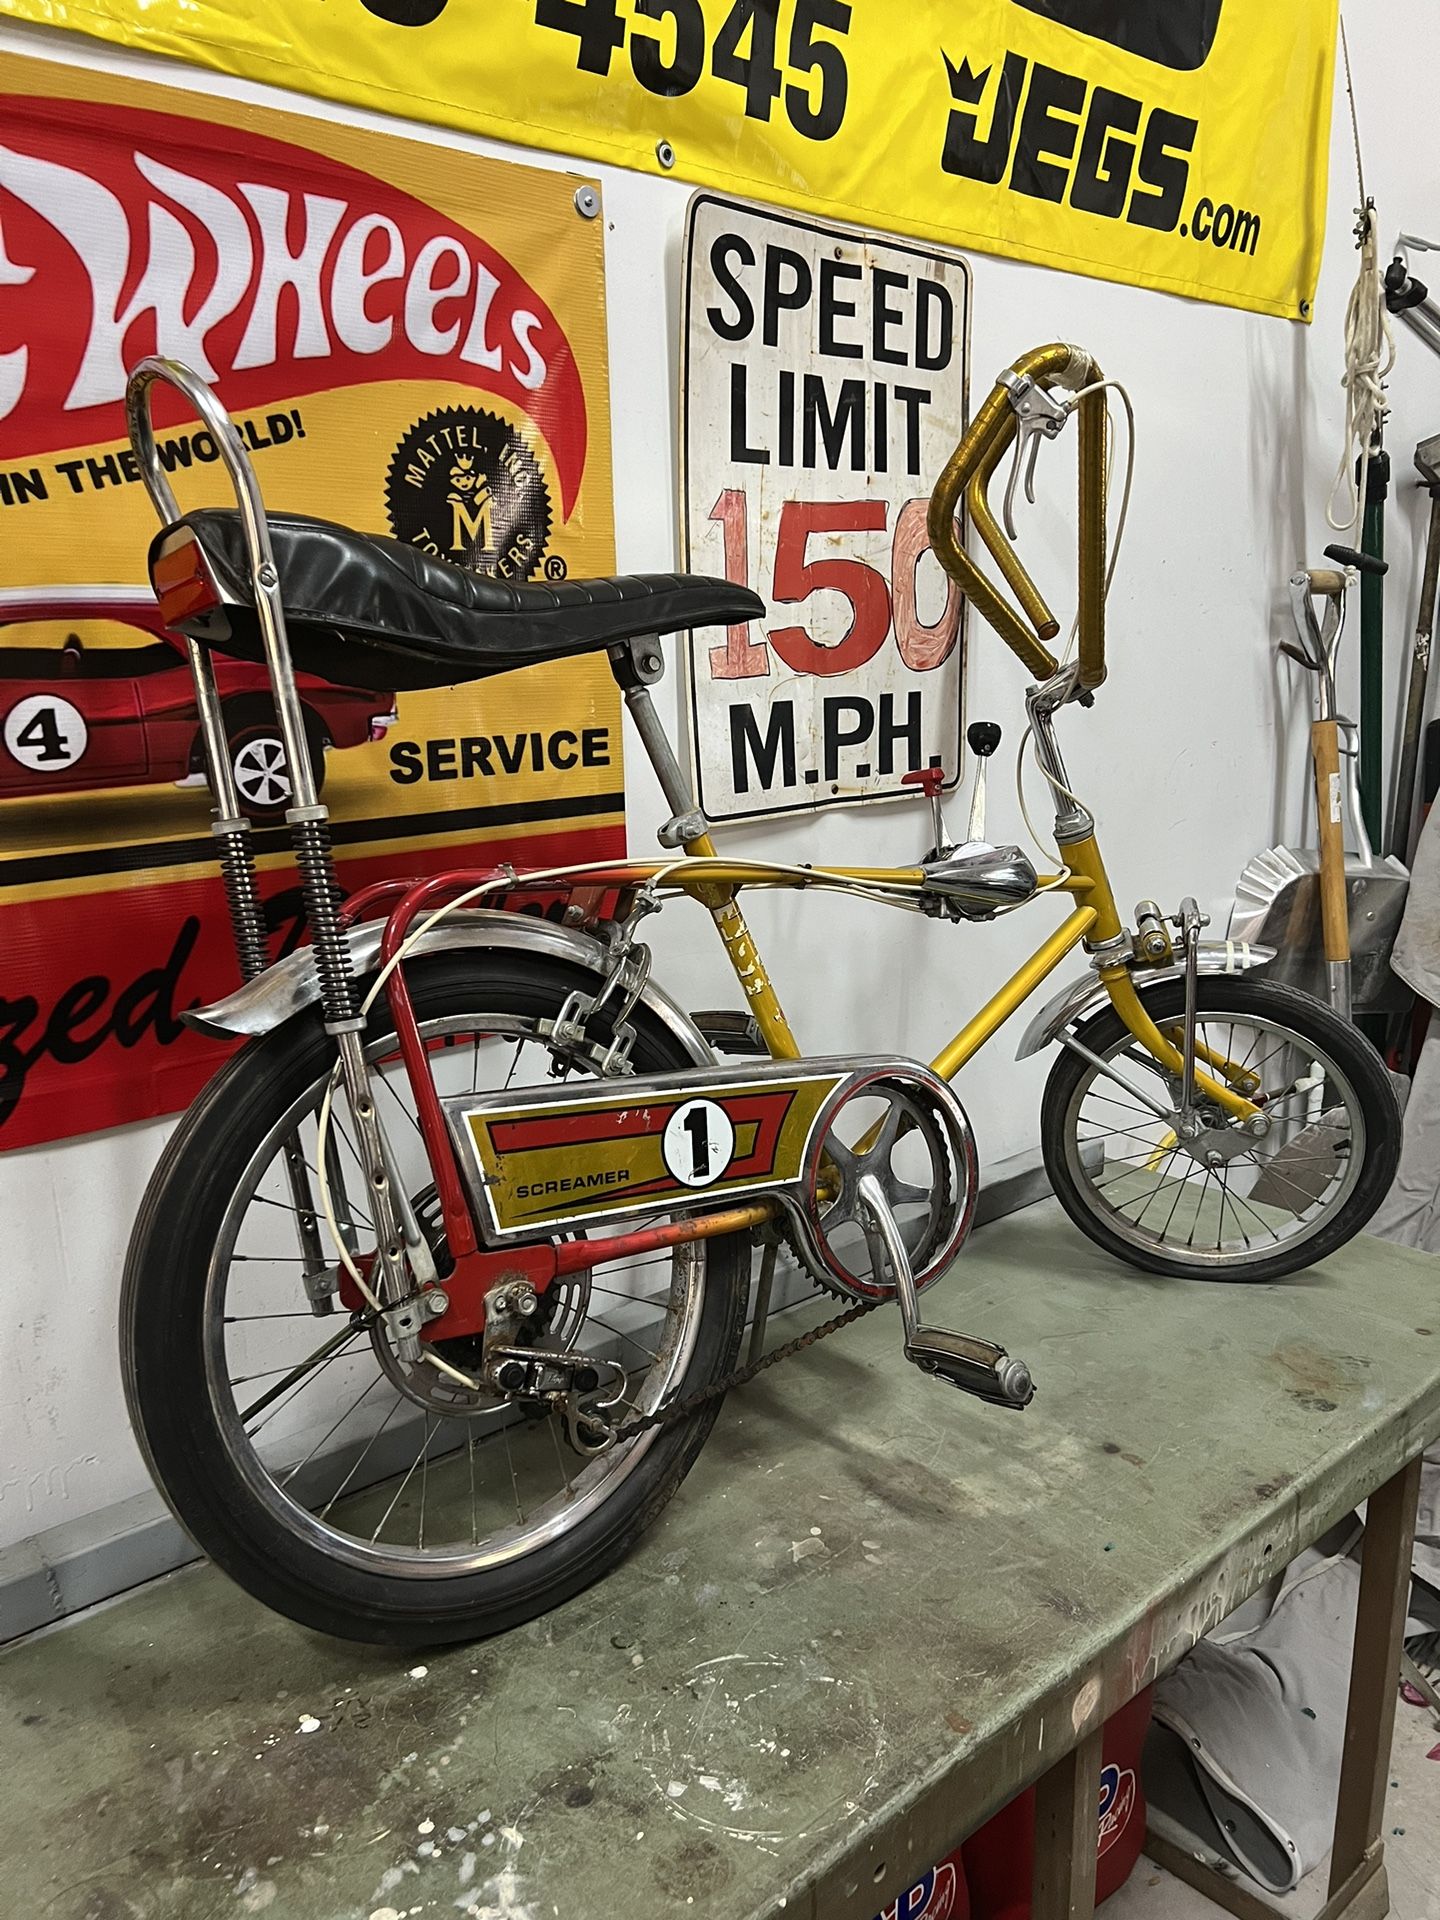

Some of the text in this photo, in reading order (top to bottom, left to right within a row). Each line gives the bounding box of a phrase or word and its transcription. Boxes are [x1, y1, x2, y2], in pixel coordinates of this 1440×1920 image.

[706, 233, 954, 372] SPEED
[55, 450, 143, 493] THE
[155, 409, 306, 472] WOLD!
[729, 363, 932, 476] LIMIT
[706, 489, 963, 680] 150
[16, 708, 69, 762] 4
[389, 728, 610, 784] SERVICE
[729, 691, 942, 793] M.P.H.
[516, 1169, 630, 1199] SCREAMER
[683, 1106, 710, 1178] 1
